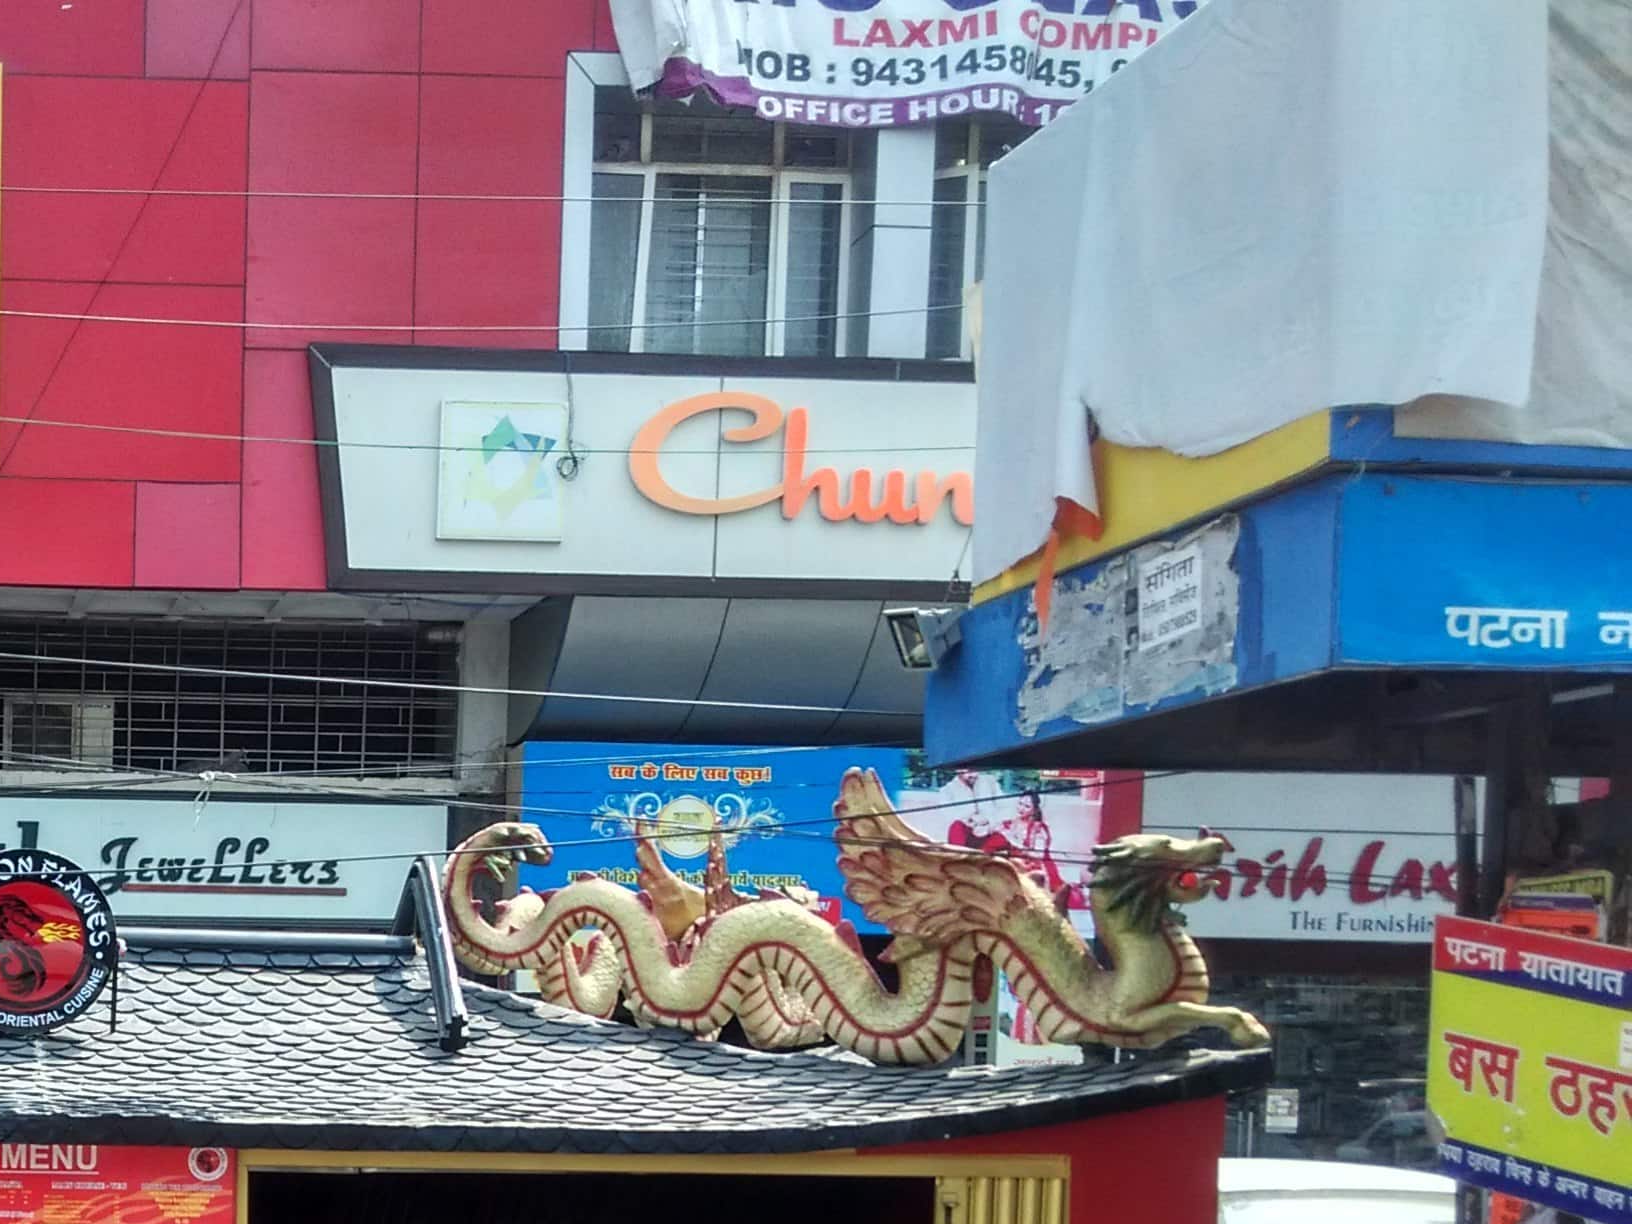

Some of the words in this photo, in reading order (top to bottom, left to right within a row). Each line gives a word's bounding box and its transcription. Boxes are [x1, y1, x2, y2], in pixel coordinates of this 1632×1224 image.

[833, 11, 998, 48] LAXMI
[757, 95, 894, 127] OFFICE
[1445, 605, 1568, 650] पटना
[609, 763, 636, 781] सब
[640, 761, 659, 780] के
[663, 762, 698, 781] लिए
[703, 765, 730, 782] सब
[41, 859, 111, 948] FLAMES
[1445, 937, 1507, 972] पटना
[1518, 949, 1625, 996] यातायात
[63, 967, 105, 1015] CUISINE
[1444, 1031, 1520, 1104] बस
[1, 1144, 99, 1171] MENU
